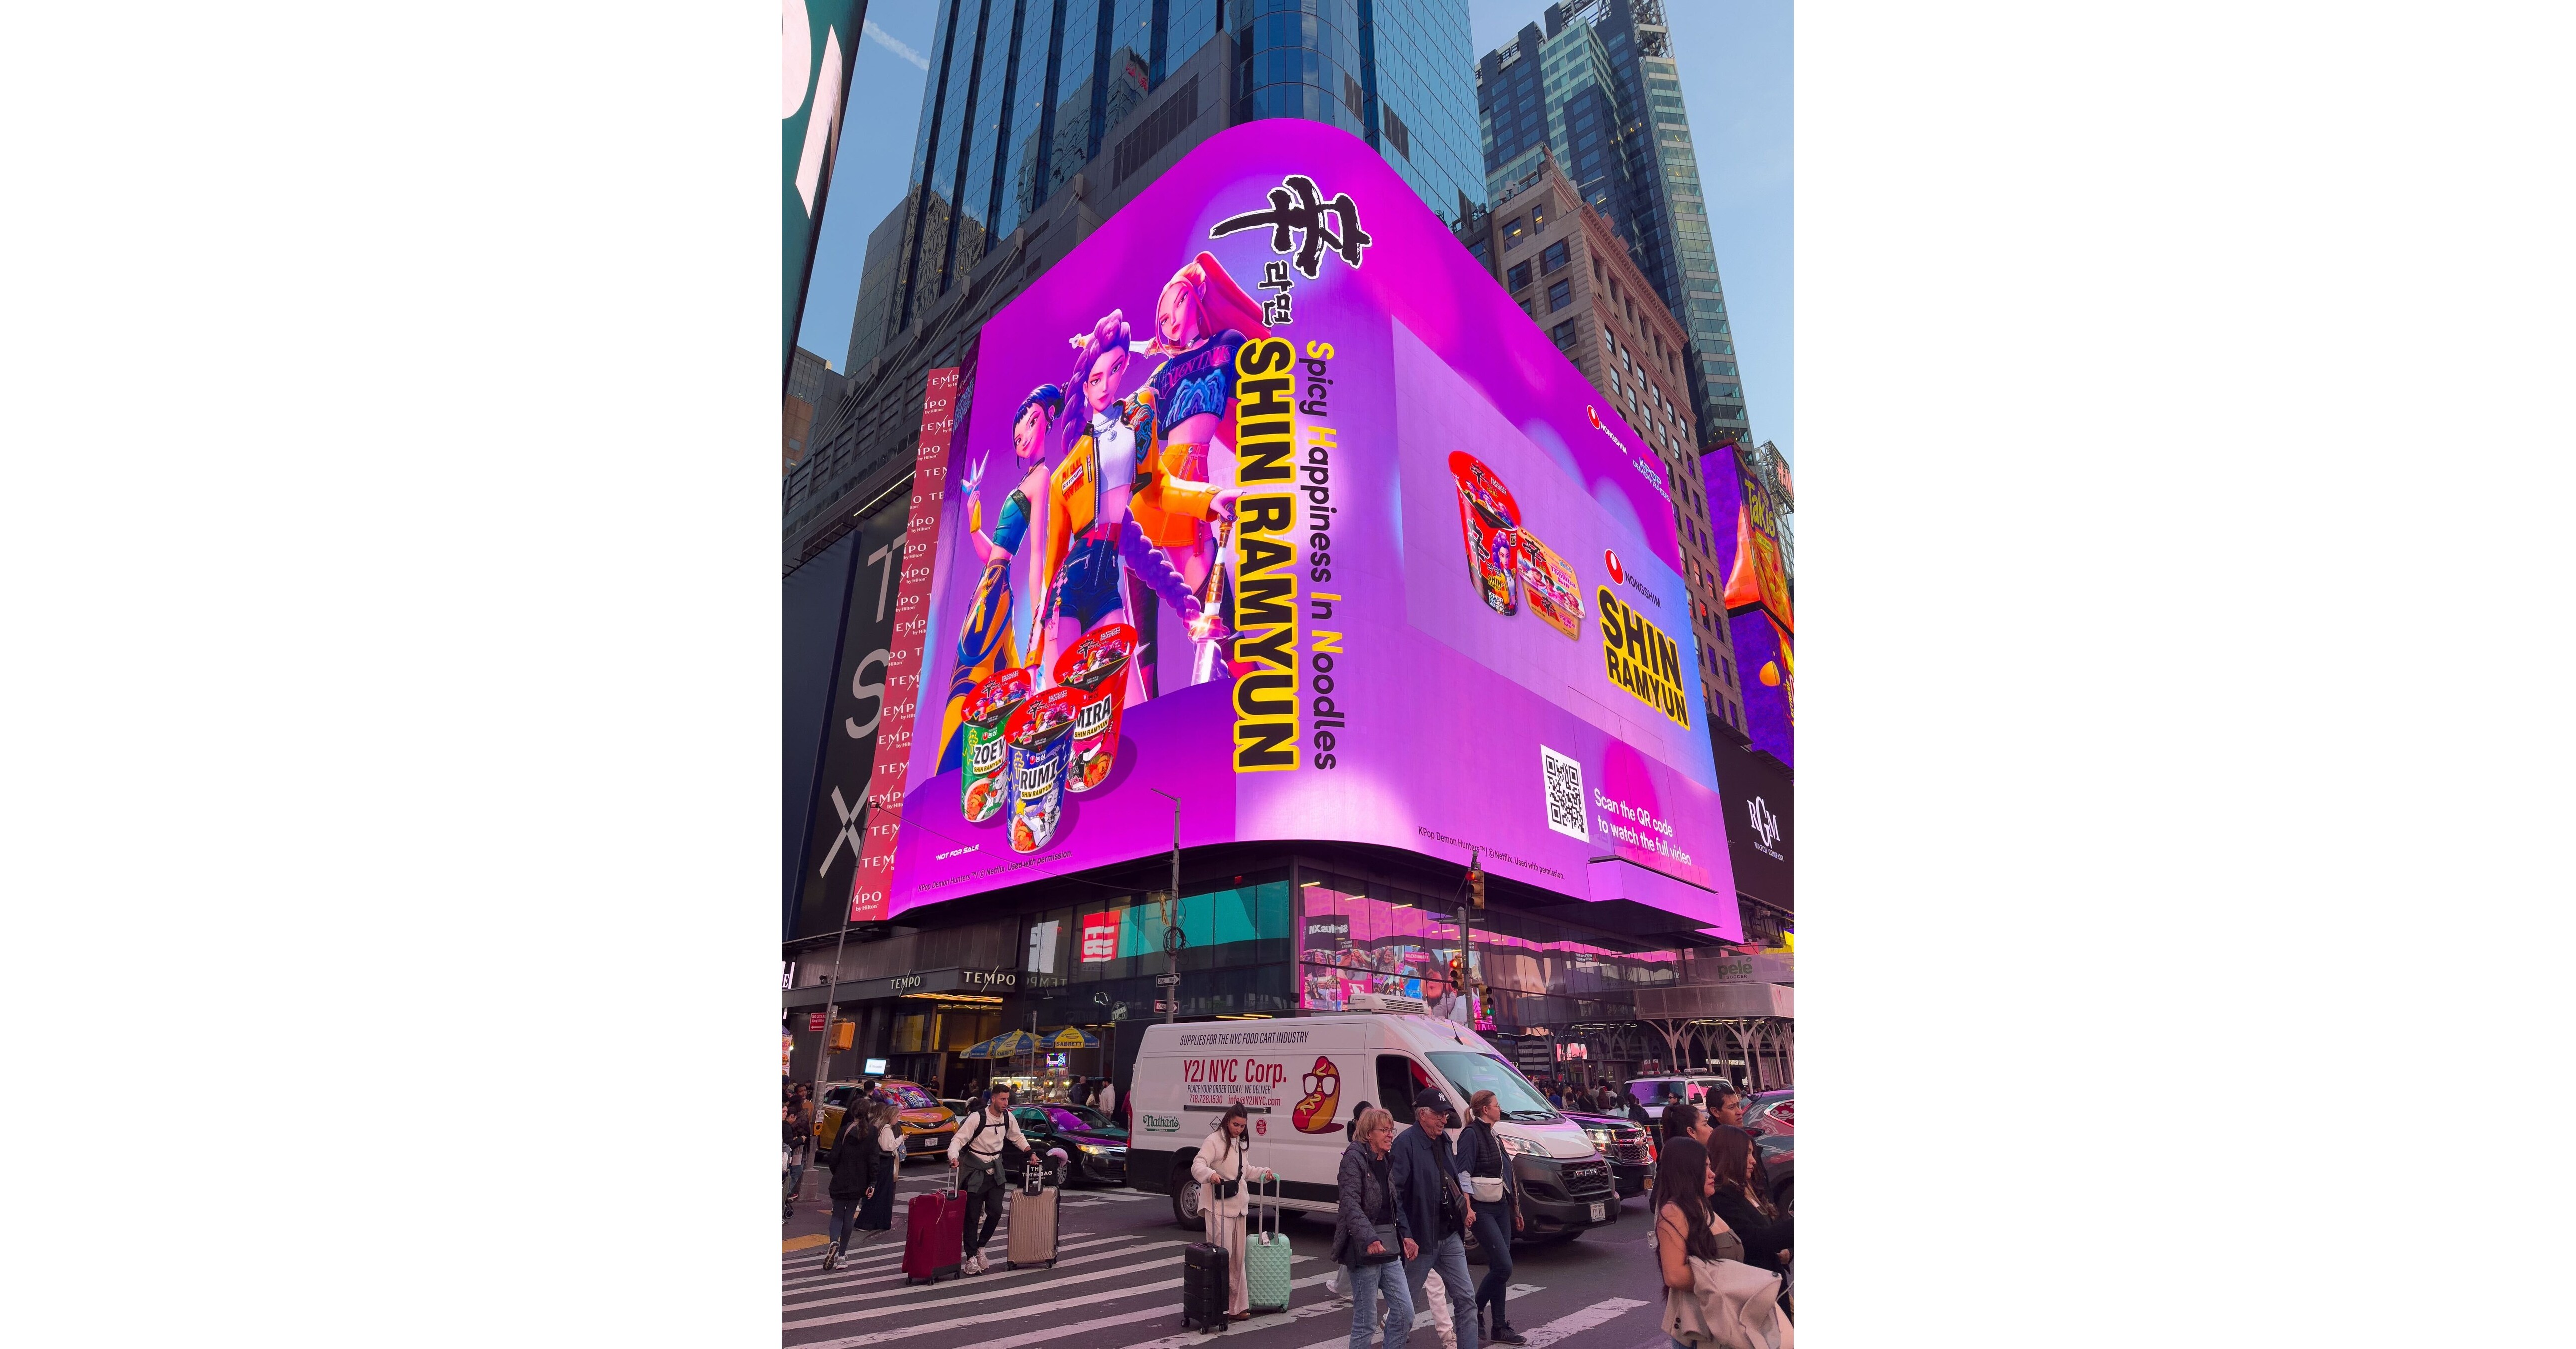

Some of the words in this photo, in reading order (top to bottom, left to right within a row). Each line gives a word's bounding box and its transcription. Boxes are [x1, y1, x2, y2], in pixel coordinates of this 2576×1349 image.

[1258, 260, 1295, 327] 라면
[1299, 340, 1334, 417] Spicy
[1237, 339, 1294, 486] SHIN
[1600, 421, 1627, 455] NONGSHIM
[1300, 426, 1338, 583] Happiness
[1745, 478, 1776, 537] Takis
[1488, 573, 1501, 586] SHIN
[1625, 571, 1661, 609] NONGSHIM
[1311, 592, 1342, 619] In
[1235, 495, 1298, 771] RAMYUN
[1598, 588, 1683, 692] SHIN
[1312, 630, 1345, 770] Noodles
[1605, 644, 1689, 728] RAMYUN
[1076, 695, 1111, 729] MIRA
[1087, 720, 1108, 736] RAMYUN
[879, 725, 913, 751] EMP
[974, 737, 1005, 765] ZOEY
[984, 758, 1002, 771] RAMYUN
[1020, 759, 1058, 790] RUMI
[869, 785, 905, 812] EMP
[1033, 784, 1052, 797] RAMYUN
[1594, 788, 1619, 815] Scan
[1620, 800, 1636, 822] the
[1636, 807, 1651, 829] QR
[1652, 819, 1673, 838] code
[1747, 796, 1781, 849] RGM
[950, 848, 963, 857] FOR
[963, 844, 979, 855] SALE
[1418, 826, 1435, 840] KPop
[1437, 832, 1457, 846] Demon
[1495, 850, 1514, 864] Netflix.
[1514, 857, 1528, 868] Used
[1528, 861, 1539, 872] with
[1539, 866, 1565, 880] permission.
[1597, 815, 1609, 834] to
[1610, 823, 1639, 846] watch
[1639, 833, 1655, 853] the
[1655, 837, 1669, 858] full
[1670, 844, 1692, 866] video
[1754, 842, 1768, 854] WATCH
[1768, 849, 1784, 862] COMPANY
[918, 883, 931, 892] KPop
[932, 878, 949, 889] Demon
[986, 865, 1007, 876] Netflix.
[1007, 862, 1022, 871] Used
[1023, 858, 1037, 869] with
[1037, 850, 1073, 865] permission.
[890, 969, 921, 997] TEMPO
[964, 965, 1016, 992] TEMPO
[1717, 957, 1753, 980] pelé
[1180, 1034, 1206, 1046] SUPPLIES
[1206, 1034, 1217, 1045] FOR
[1218, 1033, 1229, 1045] THE
[1229, 1033, 1242, 1045] NYC
[1242, 1032, 1258, 1044] FOOD
[1259, 1032, 1276, 1044] CART
[1276, 1031, 1309, 1043] INDUSTRY
[1184, 1059, 1205, 1082] Y2J
[1208, 1059, 1238, 1082] NYC
[1245, 1058, 1287, 1089] Corp.
[1187, 1084, 1200, 1093] PLACE
[1201, 1084, 1212, 1093] YOUR
[1213, 1085, 1227, 1093] ORDER
[1227, 1085, 1243, 1094] TODAY!
[1245, 1085, 1252, 1094] WE
[1253, 1085, 1271, 1094] DELIVER
[1189, 1094, 1223, 1104] 718.728.1530
[1228, 1095, 1281, 1106] info@Y2JNYC.com
